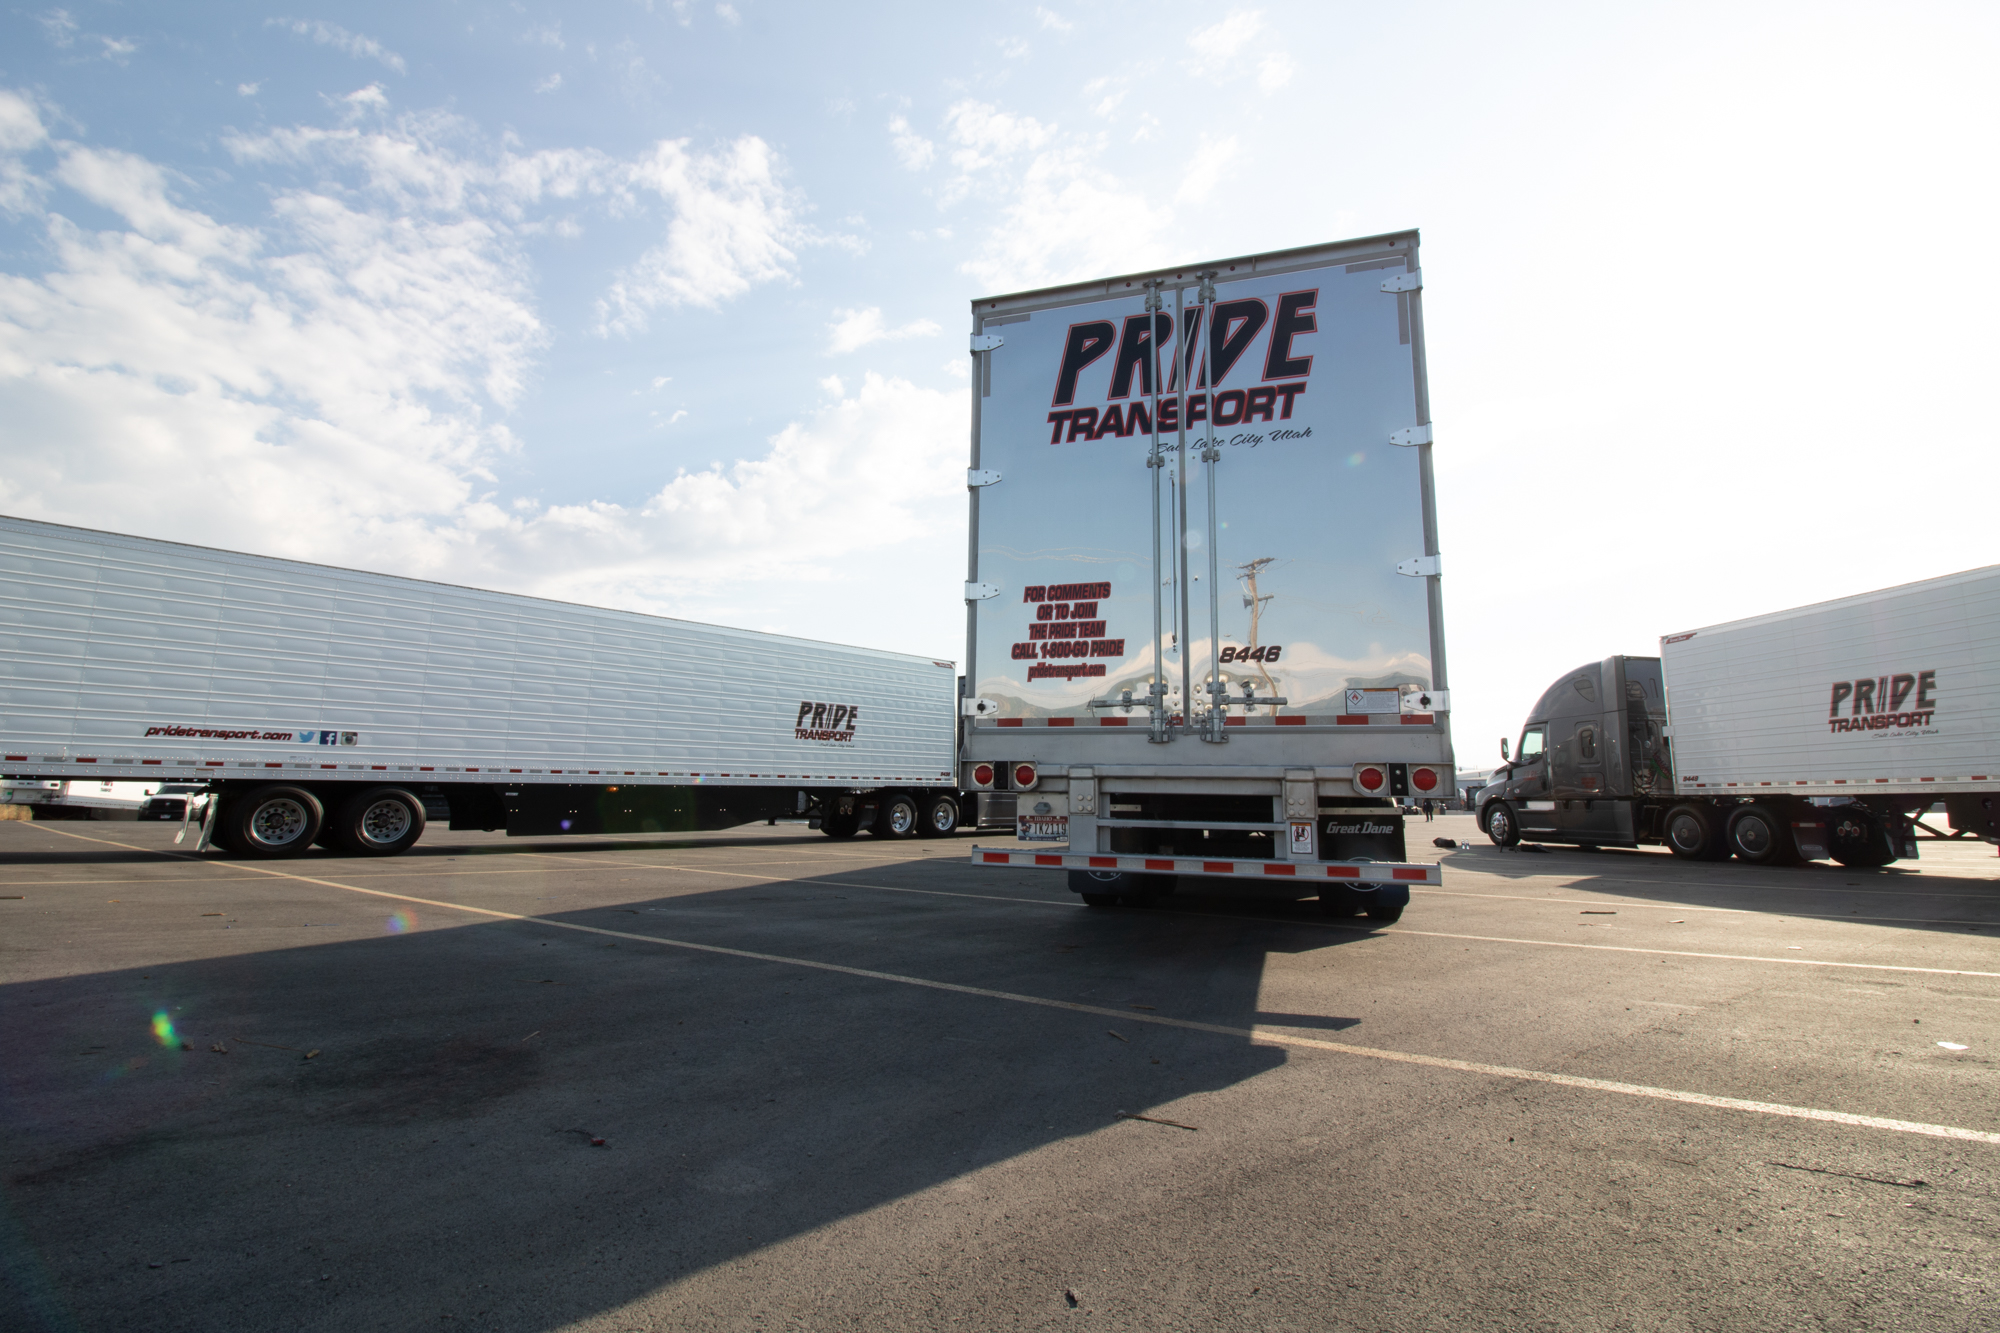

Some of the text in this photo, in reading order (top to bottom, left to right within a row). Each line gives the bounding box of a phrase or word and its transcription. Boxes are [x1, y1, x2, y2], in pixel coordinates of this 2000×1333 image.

[1051, 288, 1320, 408] PRIDE
[1047, 381, 1307, 445] TRANSPORT
[1190, 437, 1226, 450] Lake
[1230, 433, 1264, 448] City,
[1269, 426, 1313, 441] Utah
[1023, 581, 1111, 603] FOR COMMENTS
[1036, 601, 1098, 621] OR TO JOIN
[1029, 620, 1106, 640] THE PRIDE TEAM
[1011, 638, 1125, 660] CALL 1-800-GO PRIDE
[1219, 645, 1282, 663] 8446
[1027, 662, 1106, 682] pridetransport.com
[1829, 669, 1937, 718] PRIDE
[796, 701, 859, 731] PRIDE
[1828, 710, 1935, 733] TRANSPORT
[145, 725, 293, 740] pridetransport.com
[794, 728, 855, 742] TRANSPORT
[1034, 822, 1067, 835] TK2119
[1326, 821, 1394, 834] Great Dane
